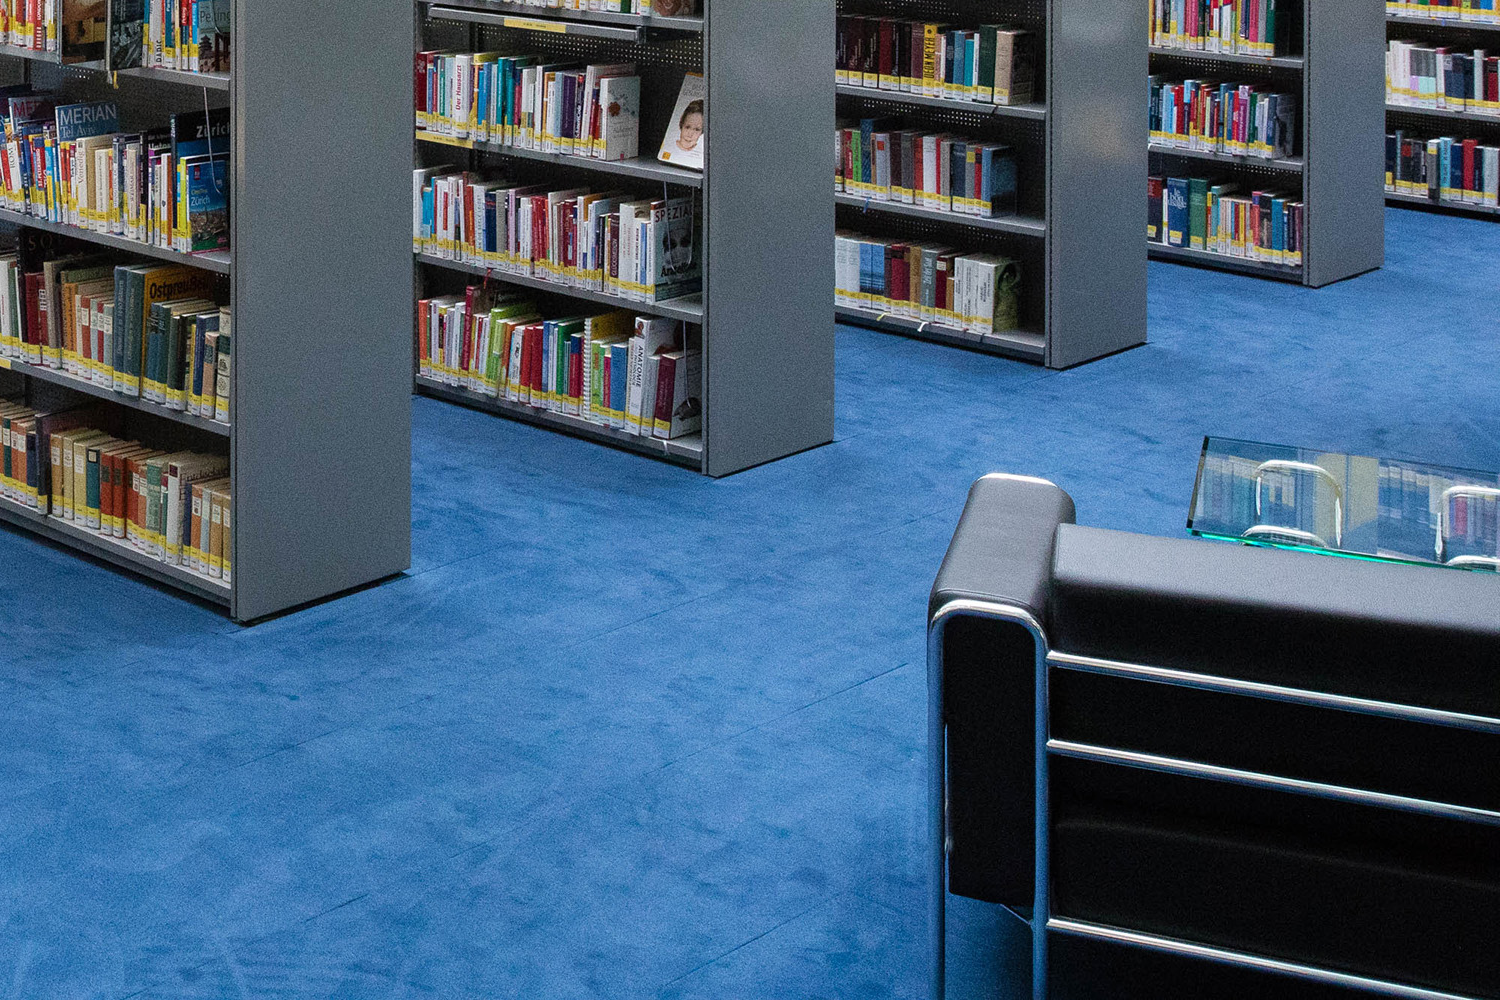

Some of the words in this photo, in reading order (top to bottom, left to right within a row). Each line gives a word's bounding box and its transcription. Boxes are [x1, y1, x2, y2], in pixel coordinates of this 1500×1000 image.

[925, 37, 935, 58] MEYER
[924, 59, 934, 79] DEON
[60, 103, 117, 126] MERIAN
[62, 126, 74, 138] Tel
[76, 125, 96, 137] Aviv
[190, 195, 211, 207] Zürich
[635, 346, 643, 388] ANATOMIE
